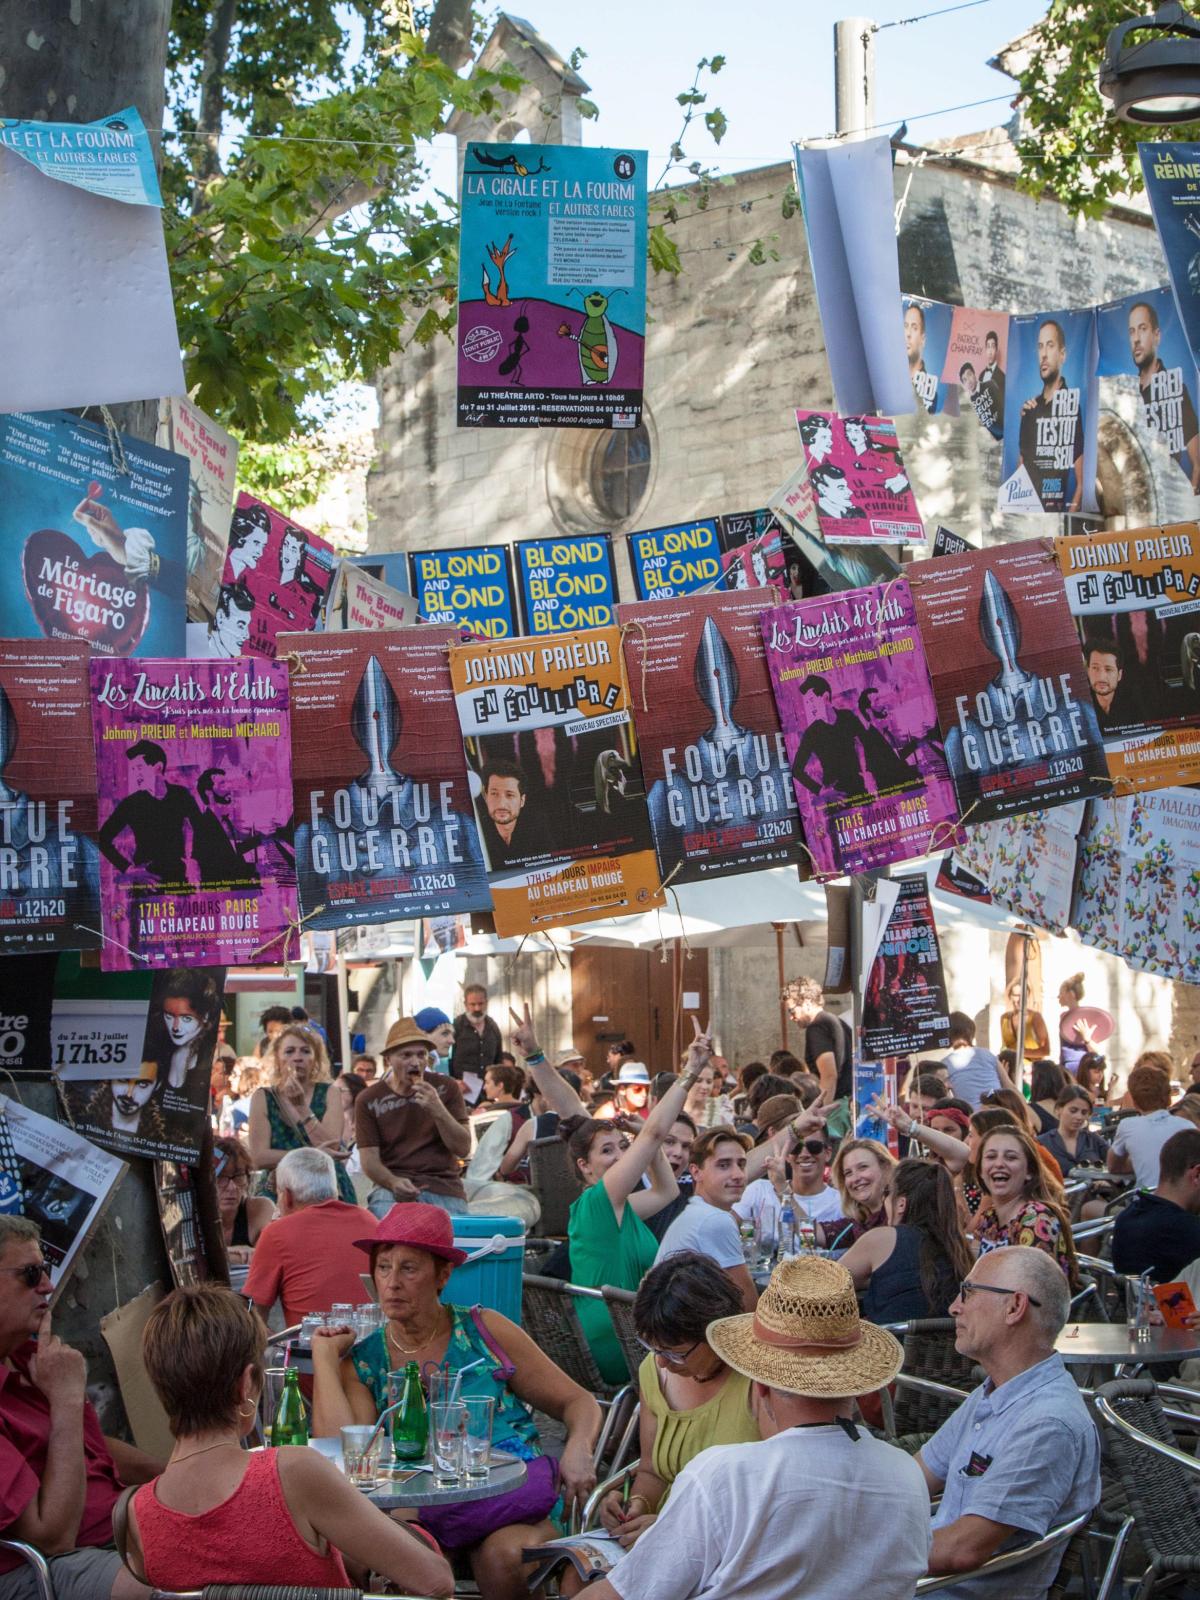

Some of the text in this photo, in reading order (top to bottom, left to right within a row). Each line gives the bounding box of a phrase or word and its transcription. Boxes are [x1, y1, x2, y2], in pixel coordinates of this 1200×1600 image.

[24, 132, 42, 147] ET
[50, 132, 72, 148] LA
[77, 132, 134, 148] FOURMI
[36, 152, 138, 164] ET AUTRES FABLES
[1158, 152, 1174, 163] LA
[1154, 164, 1200, 179] REINE
[467, 176, 635, 201] LA CIGALE ET LA FOURMI
[550, 204, 635, 218] ET AUTRES FABLES
[1150, 366, 1182, 398] FRED
[524, 392, 544, 400] ARTO
[580, 394, 598, 402] jours
[1052, 388, 1080, 417] FRED
[496, 404, 518, 412] Juillet
[1144, 396, 1184, 431] ESTOT
[578, 416, 604, 424] Avignon
[179, 406, 228, 459] The Band
[1036, 416, 1078, 446] TESTOT
[58, 456, 90, 472] un large
[72, 452, 90, 464] quoi
[176, 427, 226, 482] New York
[1054, 444, 1075, 470] SEUL
[1006, 479, 1034, 503] Palace
[727, 520, 752, 534] LIZA
[936, 532, 966, 554] le petit
[1070, 541, 1130, 569] JOHNNY
[1135, 535, 1192, 560] PRIEUR
[64, 556, 79, 570] Le
[642, 558, 668, 570] AND
[38, 557, 137, 609] Mariage
[529, 568, 554, 580] AND
[424, 579, 450, 592] AND
[649, 587, 674, 600] AND
[1079, 577, 1098, 603] EN
[1104, 568, 1200, 604] ÉQUILIBRE
[38, 584, 126, 630] de Figaro
[356, 584, 405, 622] The Band
[533, 600, 559, 612] AND
[351, 606, 374, 628] New
[368, 607, 385, 622] from
[428, 612, 455, 624] AND
[78, 626, 90, 637] de
[257, 618, 268, 634] LA
[770, 621, 794, 653] Les
[792, 612, 850, 648] Zinedits
[854, 598, 906, 627] d'Edith
[465, 640, 611, 684] JOHNNY PRIEUR
[780, 638, 914, 682] Johnny PRIEUR Matthieu MICHARD
[97, 673, 130, 710] Les
[132, 672, 206, 710] Zinedits
[212, 671, 278, 700] d'Edith
[475, 678, 618, 722] EN ÉQUILIBRE
[956, 673, 1077, 733] FOUTUE
[102, 722, 280, 742] Johnny PRIEUR et Matthieu MICHARD
[569, 714, 627, 734] NOUVEAU SPECTACLE
[962, 710, 1088, 771] GUERRE
[1122, 735, 1175, 752] 17H15 JOURS
[662, 732, 790, 786] FOUTUE
[1124, 746, 1178, 764] AU CHAPEAU
[1054, 756, 1084, 776] 12h20
[310, 782, 456, 831] FOUTUE
[667, 772, 798, 827] GUERRE
[1142, 796, 1156, 809] LE
[834, 813, 863, 832] 17H15
[900, 796, 928, 814] PAIRS
[763, 820, 793, 838] 12h20
[838, 809, 931, 848] AU CHAPEAU ROUGE
[312, 824, 464, 874] GUERRE
[419, 874, 456, 891] 12h20
[526, 859, 621, 886] 17H15 JOURS IMPAIRS
[528, 872, 624, 900] AU CHAPEAU ROUGE
[25, 900, 66, 918] 12h20
[139, 898, 259, 919] 17H15 JOURS PAIRS
[139, 914, 259, 934] AU CHAPEAU ROUGE
[58, 1032, 68, 1040] du
[70, 1032, 76, 1040] 7
[90, 1032, 101, 1040] 31
[103, 1032, 128, 1042] juillet
[55, 1043, 128, 1064] 17h35
[86, 1124, 105, 1135] Théâtre
[169, 1143, 200, 1156] Teinturiers
